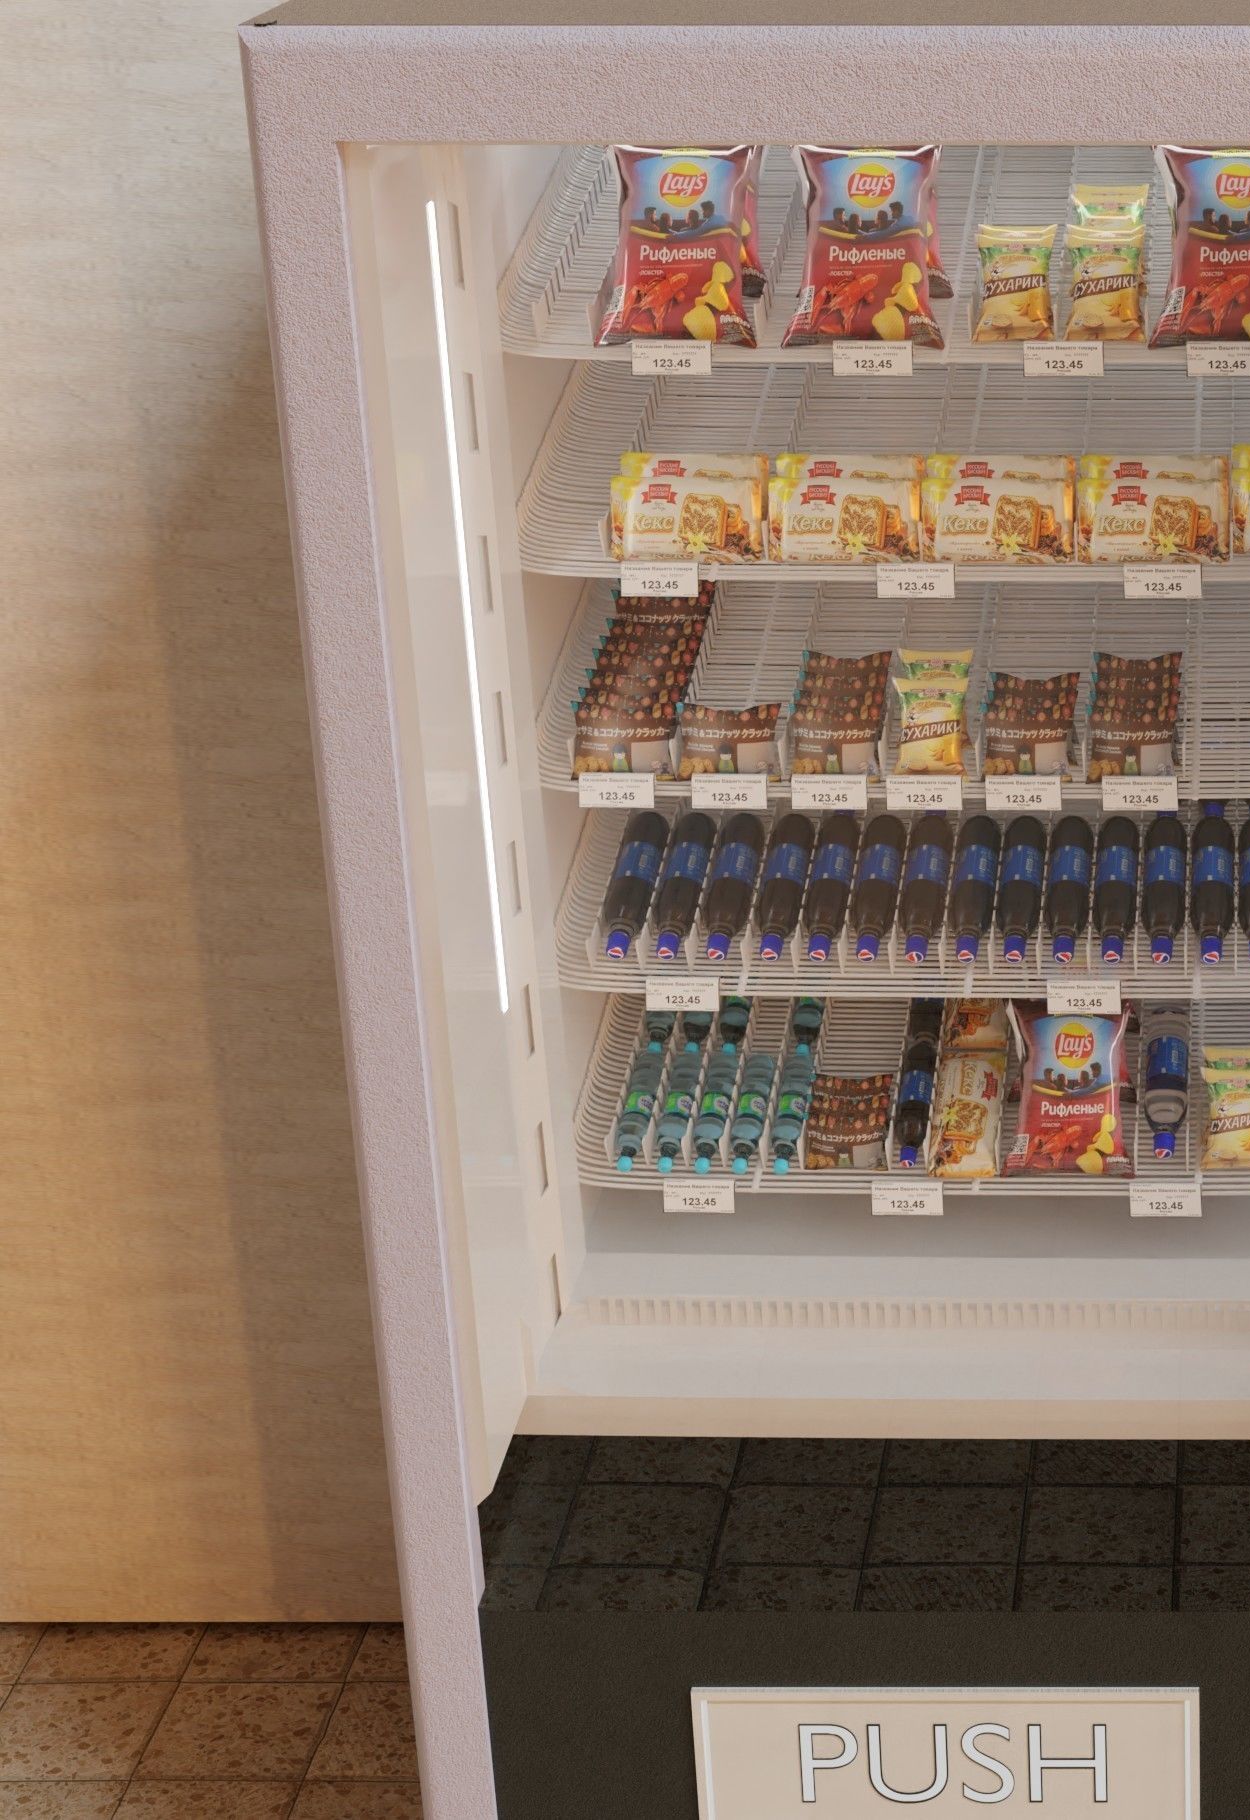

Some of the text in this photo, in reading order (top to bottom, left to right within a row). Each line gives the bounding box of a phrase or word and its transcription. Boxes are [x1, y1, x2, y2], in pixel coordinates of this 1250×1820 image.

[662, 172, 707, 198] Lay's
[850, 172, 895, 198] Lay's
[640, 245, 717, 264] Рифленые
[829, 245, 906, 264] Рифленые
[653, 359, 691, 368] 123.45
[854, 360, 892, 368] 123.45
[1045, 361, 1083, 369] 123.45
[1208, 361, 1246, 369] 123.45
[642, 581, 678, 589] 123.45
[898, 583, 934, 591] 123.45
[1145, 583, 1182, 591] 123.45
[600, 792, 635, 800] 123.45
[712, 793, 747, 801] 123.45
[812, 794, 847, 802] 123.45
[1006, 795, 1041, 803] 123.45
[1123, 795, 1158, 803] 123.45
[666, 996, 700, 1004] 123.45
[1067, 999, 1102, 1007] 123.45
[1057, 1036, 1094, 1060] Lay's
[1041, 1101, 1104, 1117] Рифленые
[1149, 1202, 1183, 1210] 123.45
[797, 1722, 1109, 1804] PUSH
